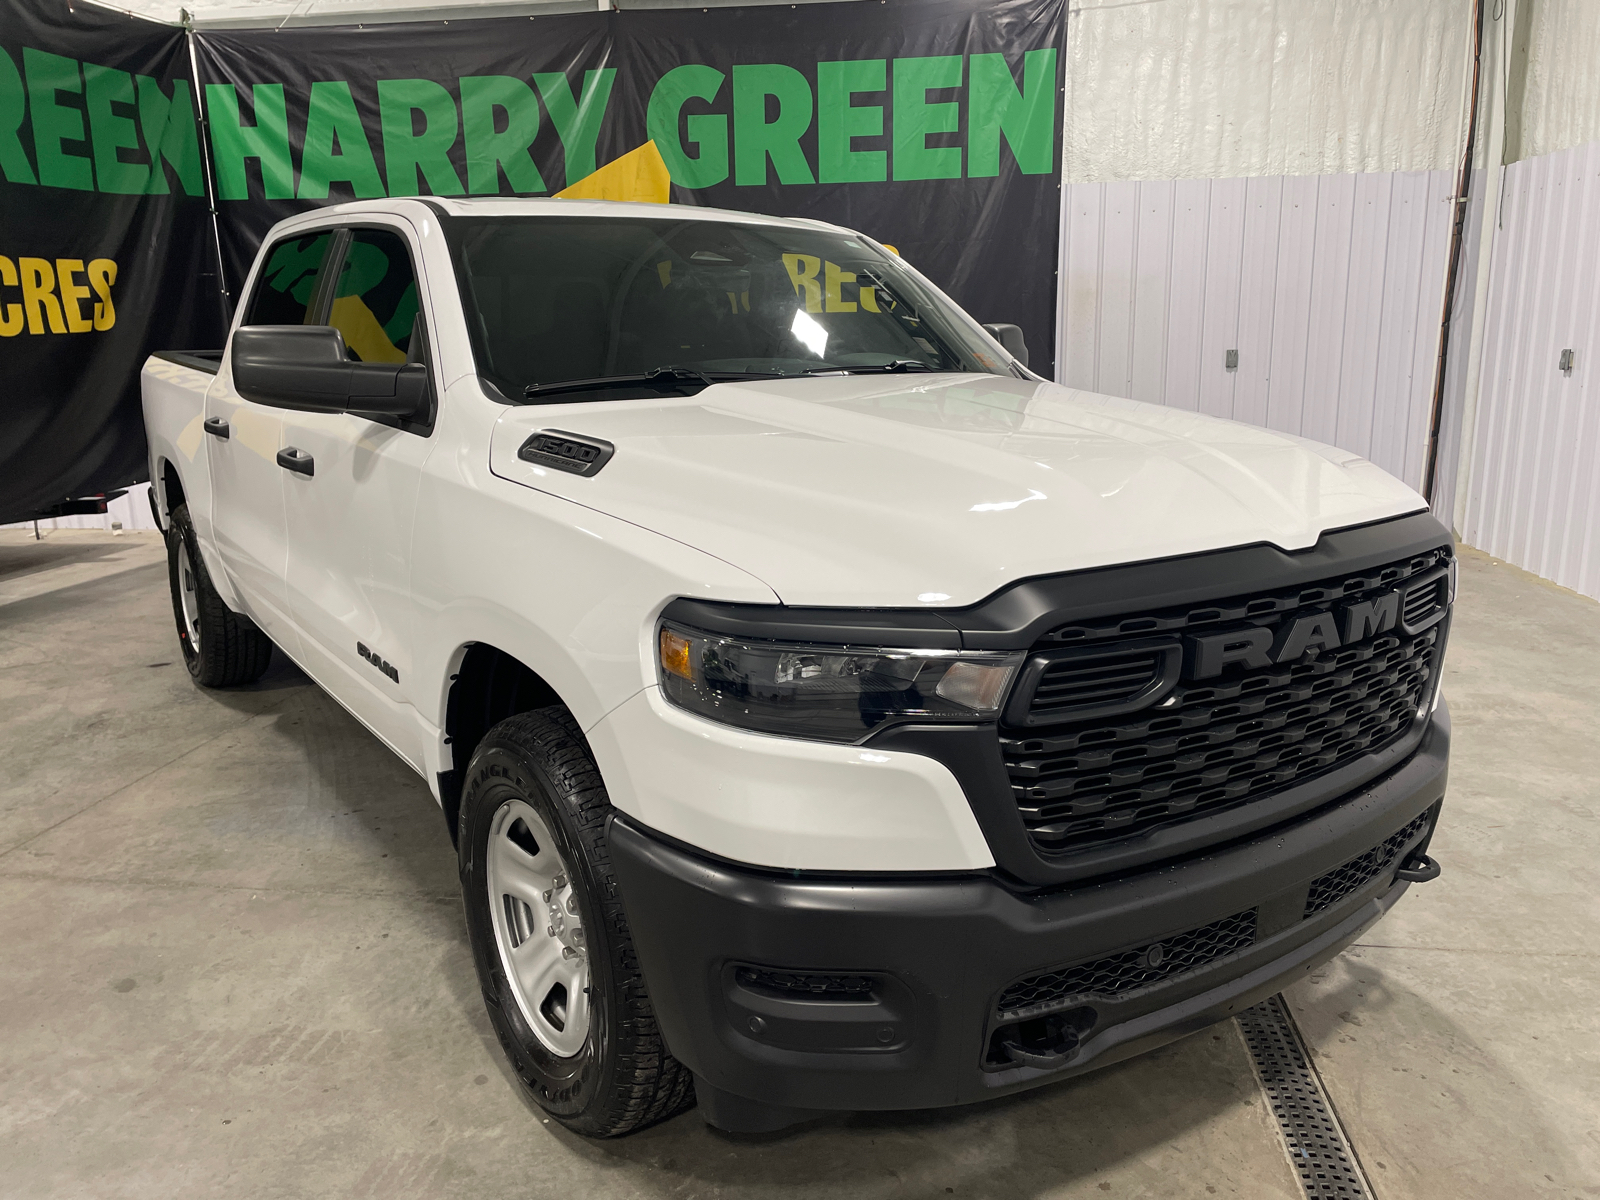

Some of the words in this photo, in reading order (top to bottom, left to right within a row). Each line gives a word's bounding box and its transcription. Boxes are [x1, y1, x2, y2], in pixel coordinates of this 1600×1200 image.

[205, 67, 618, 200] HARRY
[646, 48, 1057, 189] GREEN
[533, 437, 598, 463] 1500
[357, 641, 399, 684] RAM
[1188, 590, 1399, 681] RAM
